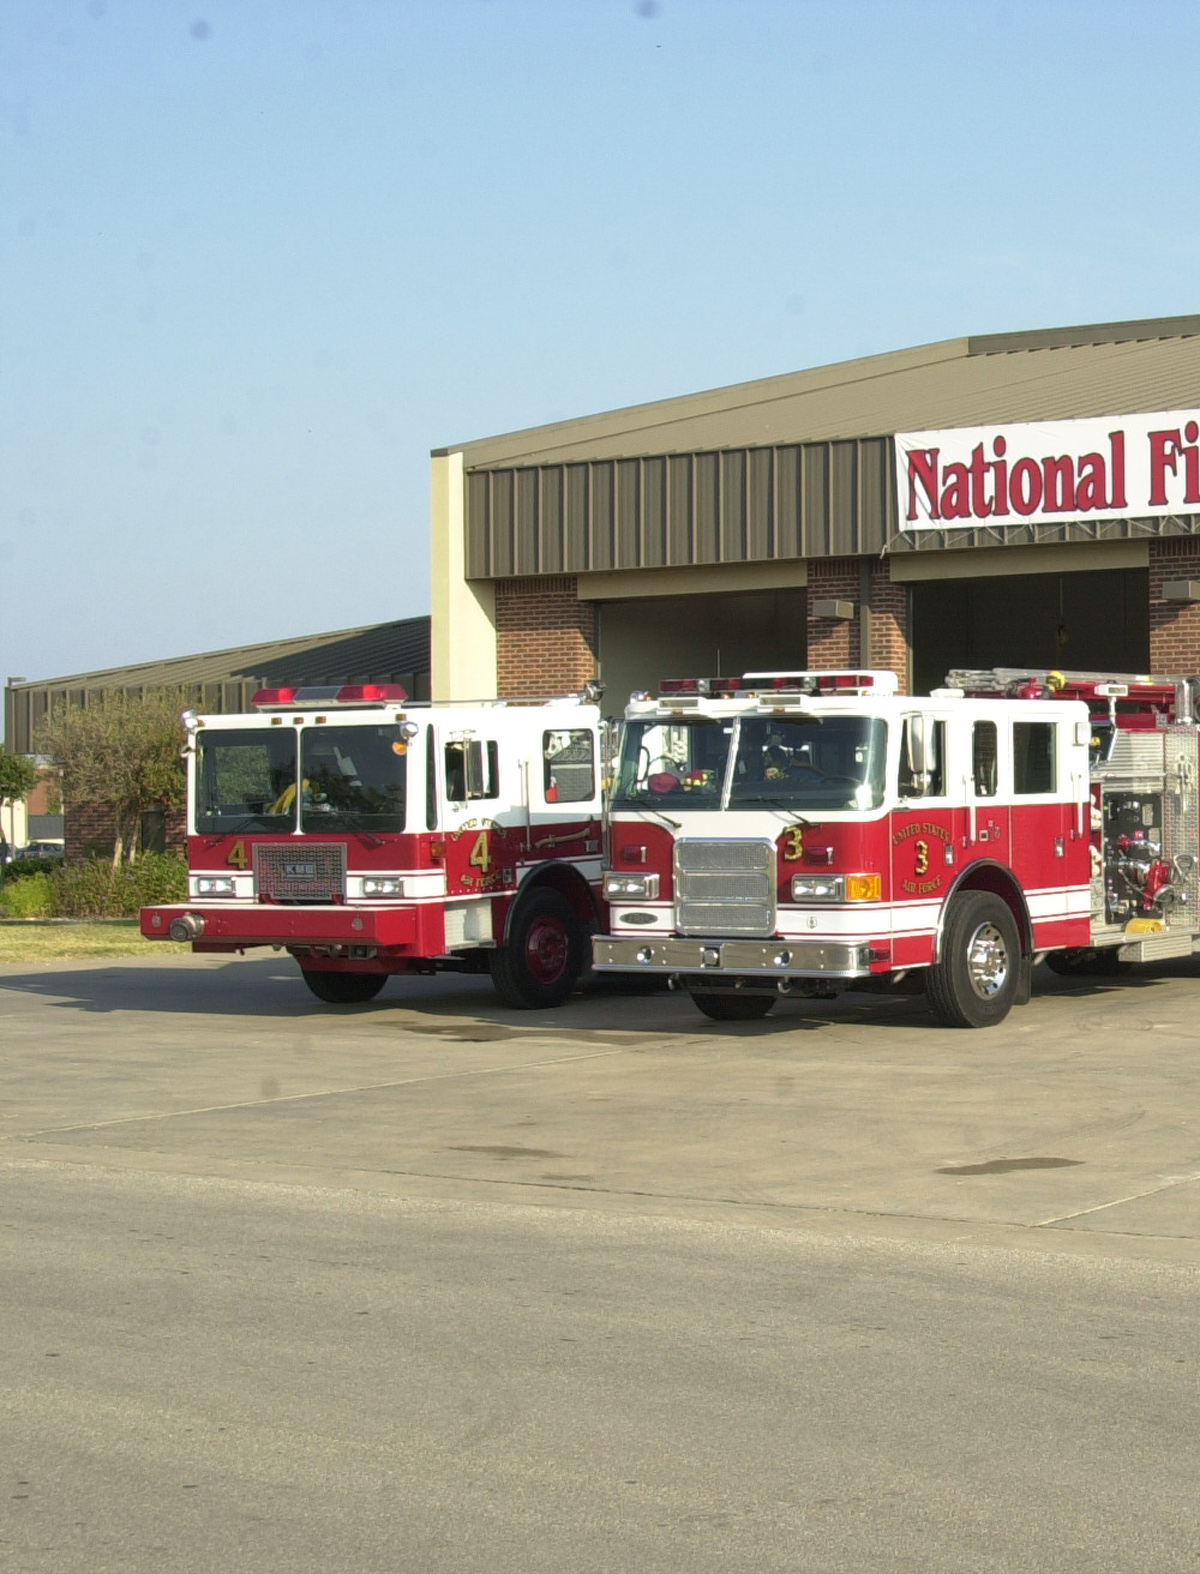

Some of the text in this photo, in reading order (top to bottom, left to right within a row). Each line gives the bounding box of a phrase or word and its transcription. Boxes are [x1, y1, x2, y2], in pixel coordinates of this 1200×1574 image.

[905, 430, 1128, 521] National
[469, 831, 491, 873] 4
[784, 825, 803, 862] 3
[892, 822, 949, 846] UNITED STATES
[227, 840, 247, 870] 4
[915, 840, 928, 876] 3
[902, 873, 942, 894] AIR FORCE
